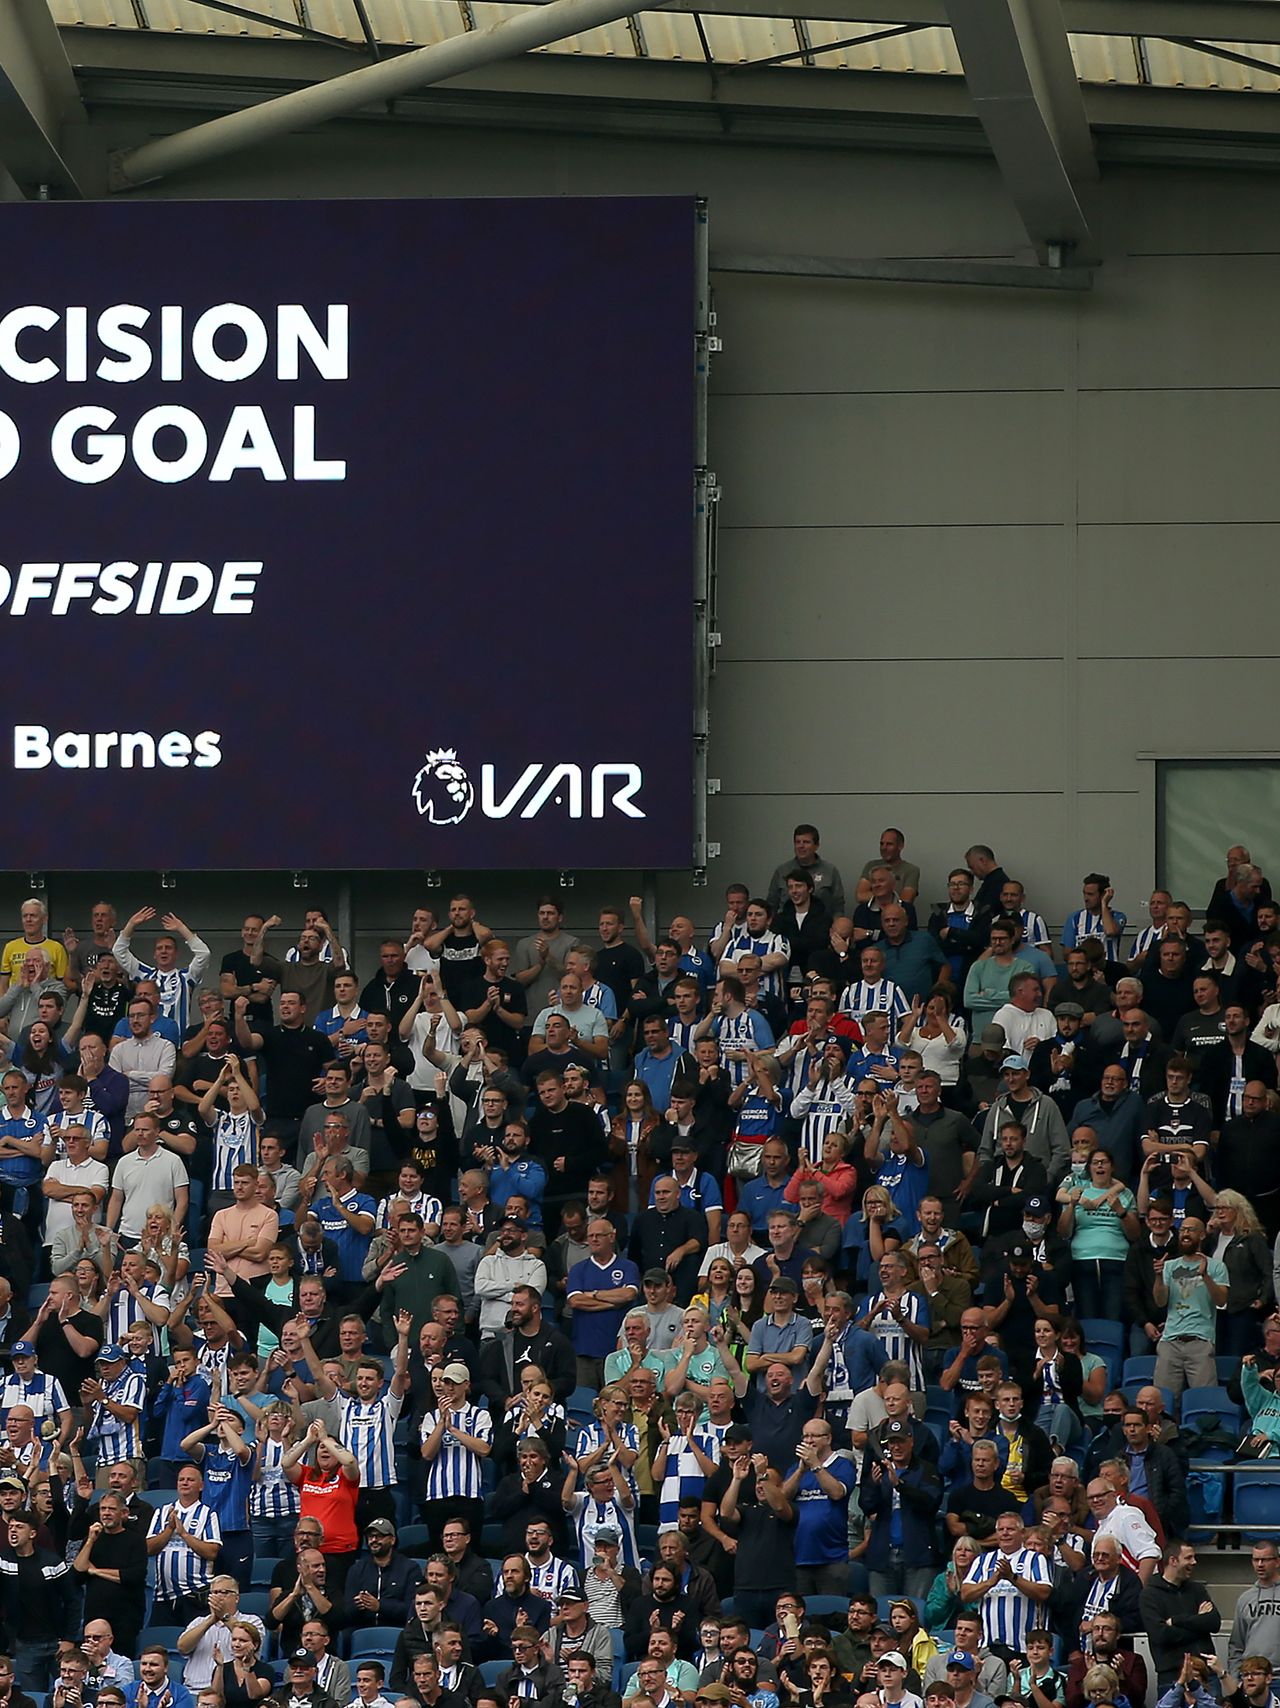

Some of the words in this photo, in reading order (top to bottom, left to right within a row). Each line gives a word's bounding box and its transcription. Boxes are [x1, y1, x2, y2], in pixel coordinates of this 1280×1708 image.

[51, 404, 347, 485] GOAL
[14, 725, 222, 769] Barnes
[481, 763, 648, 819] VAR
